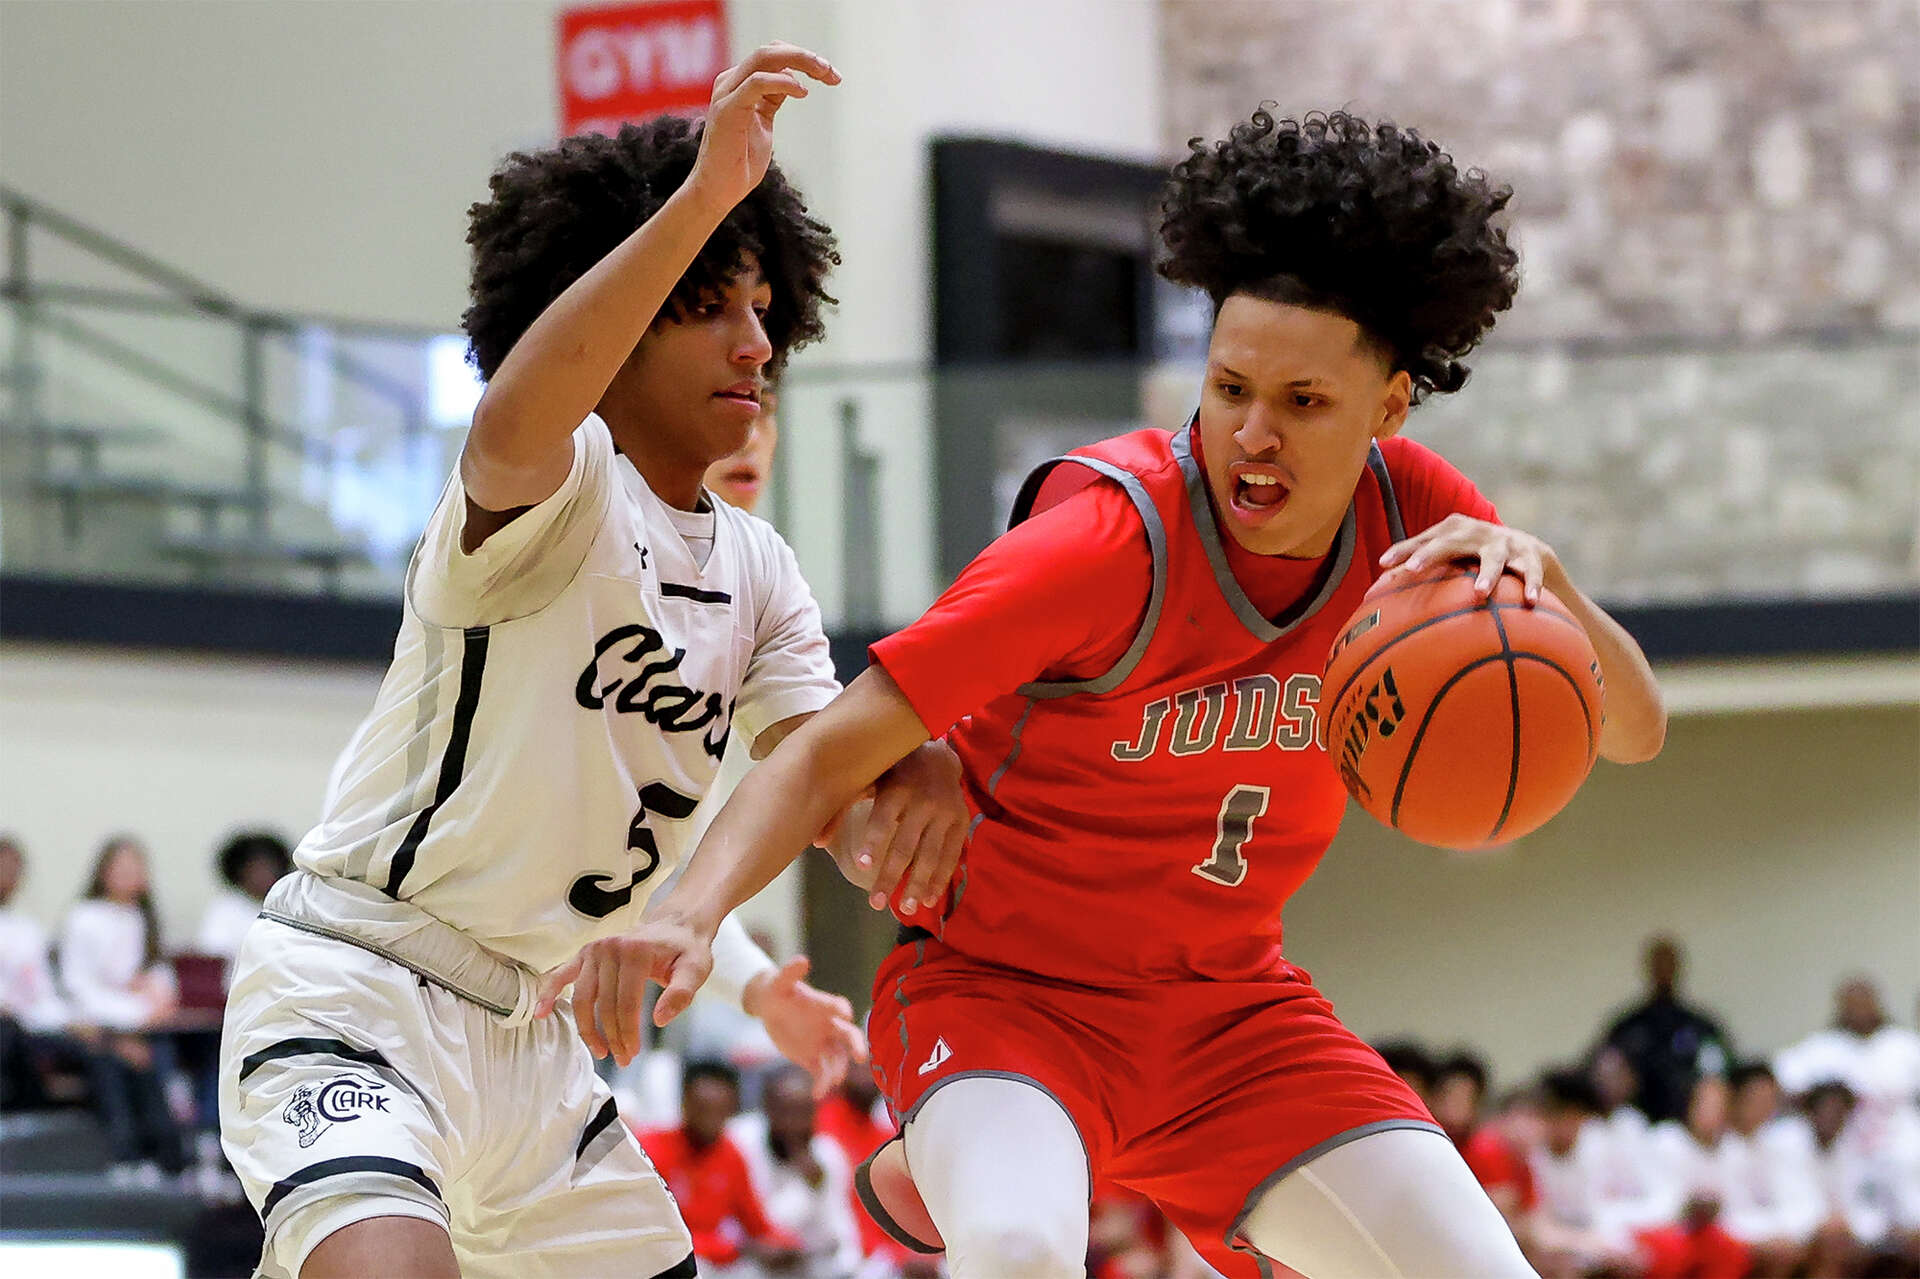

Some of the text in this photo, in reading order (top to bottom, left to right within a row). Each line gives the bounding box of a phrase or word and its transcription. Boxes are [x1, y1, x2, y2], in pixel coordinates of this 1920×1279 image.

[568, 17, 717, 100] GYM
[1110, 673, 1328, 762] JUDS
[565, 778, 702, 922] 5
[1190, 783, 1271, 888] 1
[316, 1079, 392, 1123] CLARK
